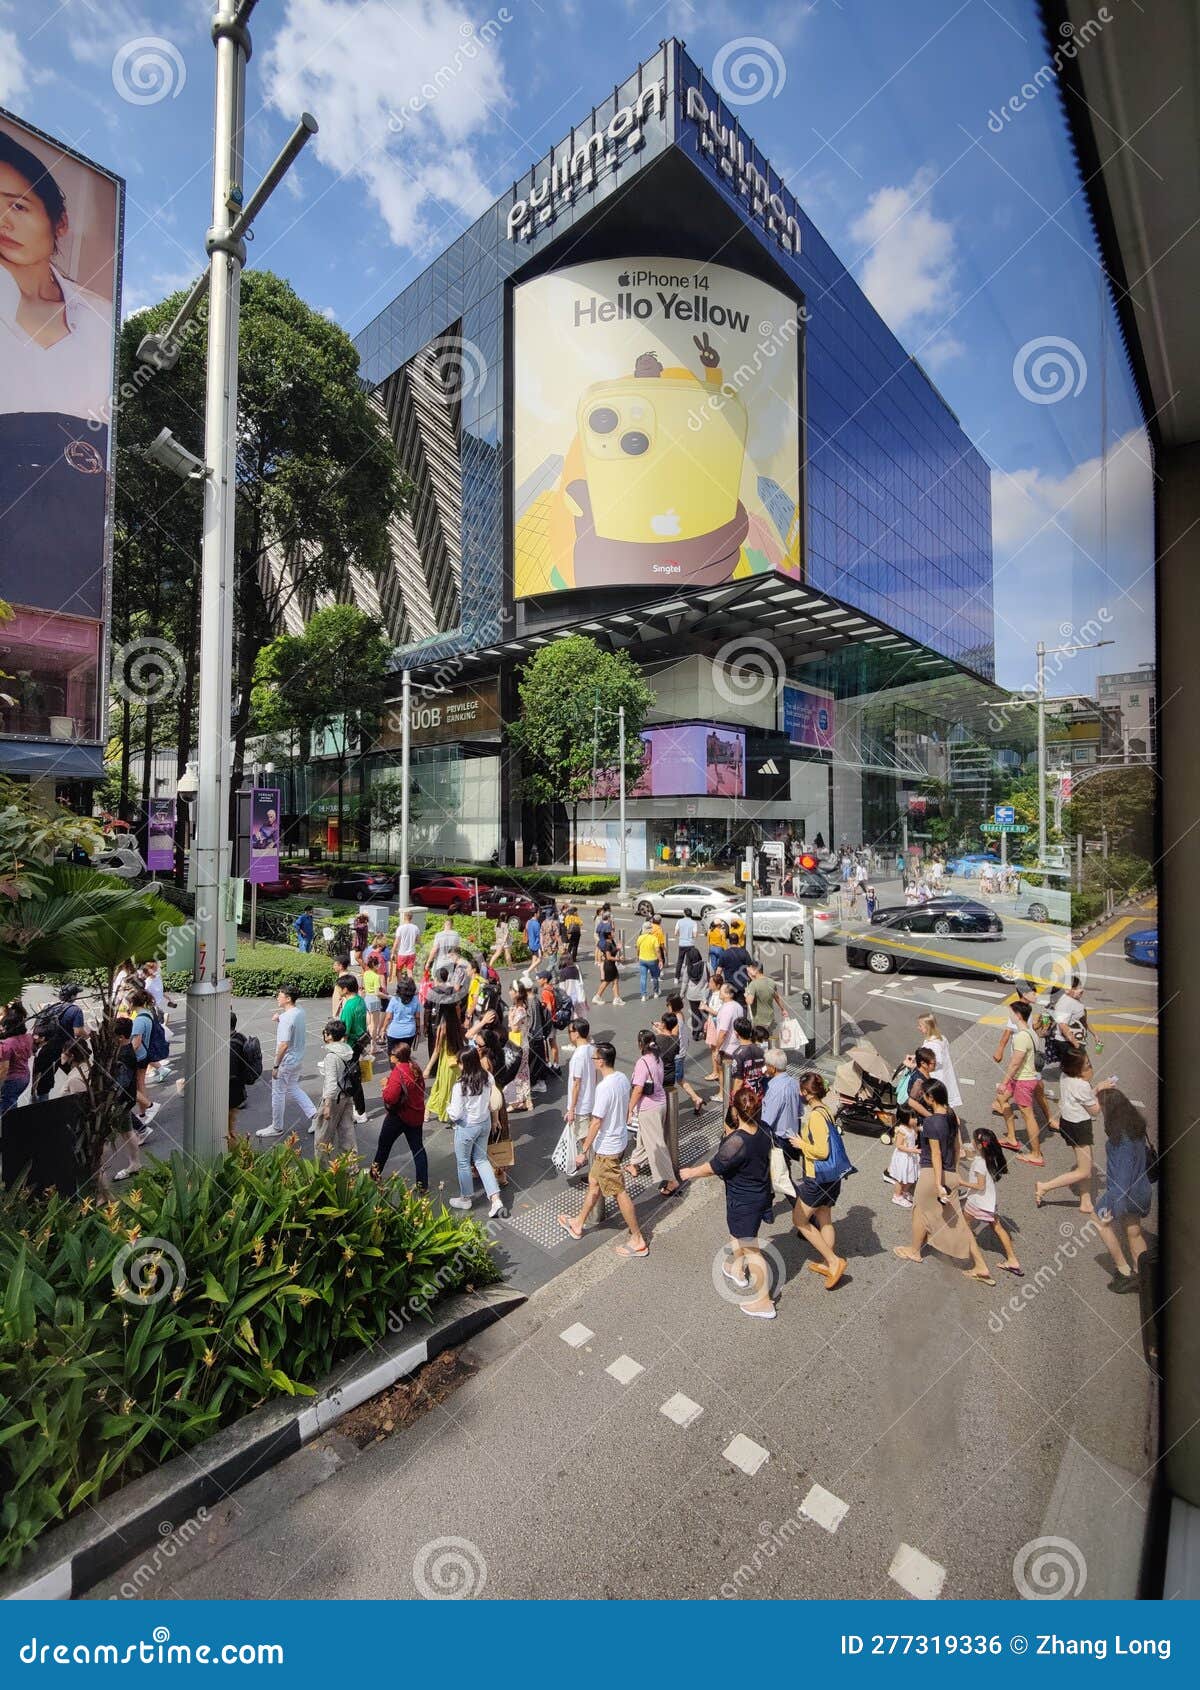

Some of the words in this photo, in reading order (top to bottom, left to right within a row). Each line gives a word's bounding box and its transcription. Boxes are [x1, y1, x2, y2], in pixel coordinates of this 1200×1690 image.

[507, 81, 663, 240] pullman
[687, 86, 801, 254] pullman
[632, 271, 690, 289] iPhone
[692, 274, 710, 291] 14
[573, 292, 653, 327] Hello
[656, 292, 750, 333] Yellow
[652, 564, 681, 575] Singtel
[446, 700, 479, 714] PRIVILEGE
[446, 711, 476, 723] BANKING
[411, 707, 441, 731] UOB
